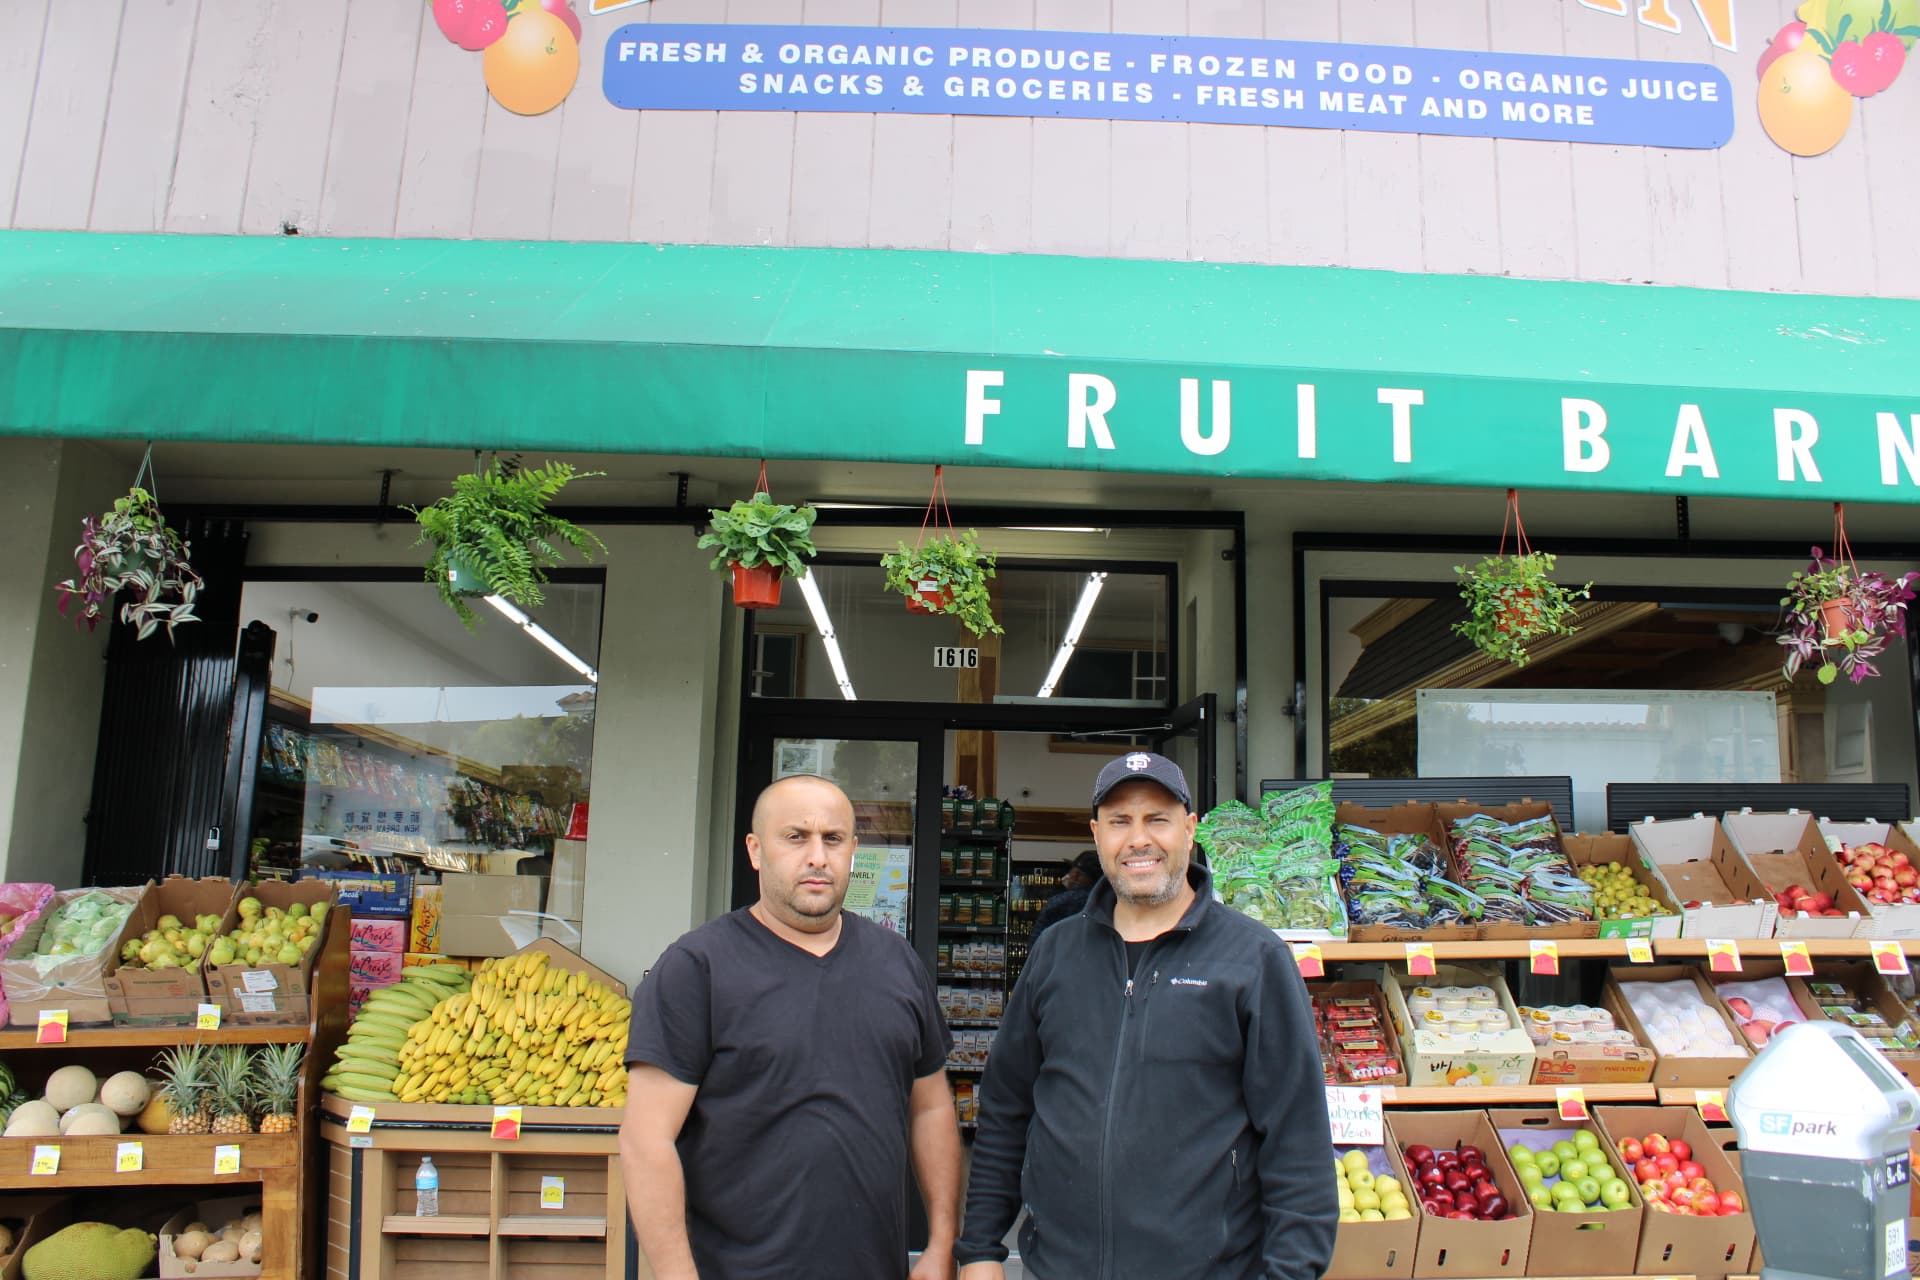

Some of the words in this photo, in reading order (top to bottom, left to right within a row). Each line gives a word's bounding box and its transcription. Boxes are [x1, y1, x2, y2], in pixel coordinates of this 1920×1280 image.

[619, 42, 727, 63] FRESH
[741, 42, 763, 63] &
[778, 43, 934, 66] ORGANIC
[949, 46, 1112, 72] PRODUCE
[1150, 53, 1296, 79] FROZEN
[1315, 60, 1413, 85] FOOD
[1458, 68, 1609, 97] ORGANIC
[1621, 78, 1719, 102] JUICE
[739, 72, 883, 95] SNACKS
[902, 75, 924, 96] &
[943, 75, 1153, 104] GROCERIES
[1196, 84, 1305, 110] FRESH
[1319, 90, 1409, 115] MEAT
[1420, 96, 1488, 120] AND
[1501, 100, 1595, 126] MORE
[964, 369, 1425, 463] FRUIT
[1561, 397, 1920, 487] BARN
[937, 647, 977, 667] 1616
[850, 871, 876, 880] AVERLY
[1177, 976, 1209, 987] Columbia
[1539, 1060, 1576, 1074] Dole
